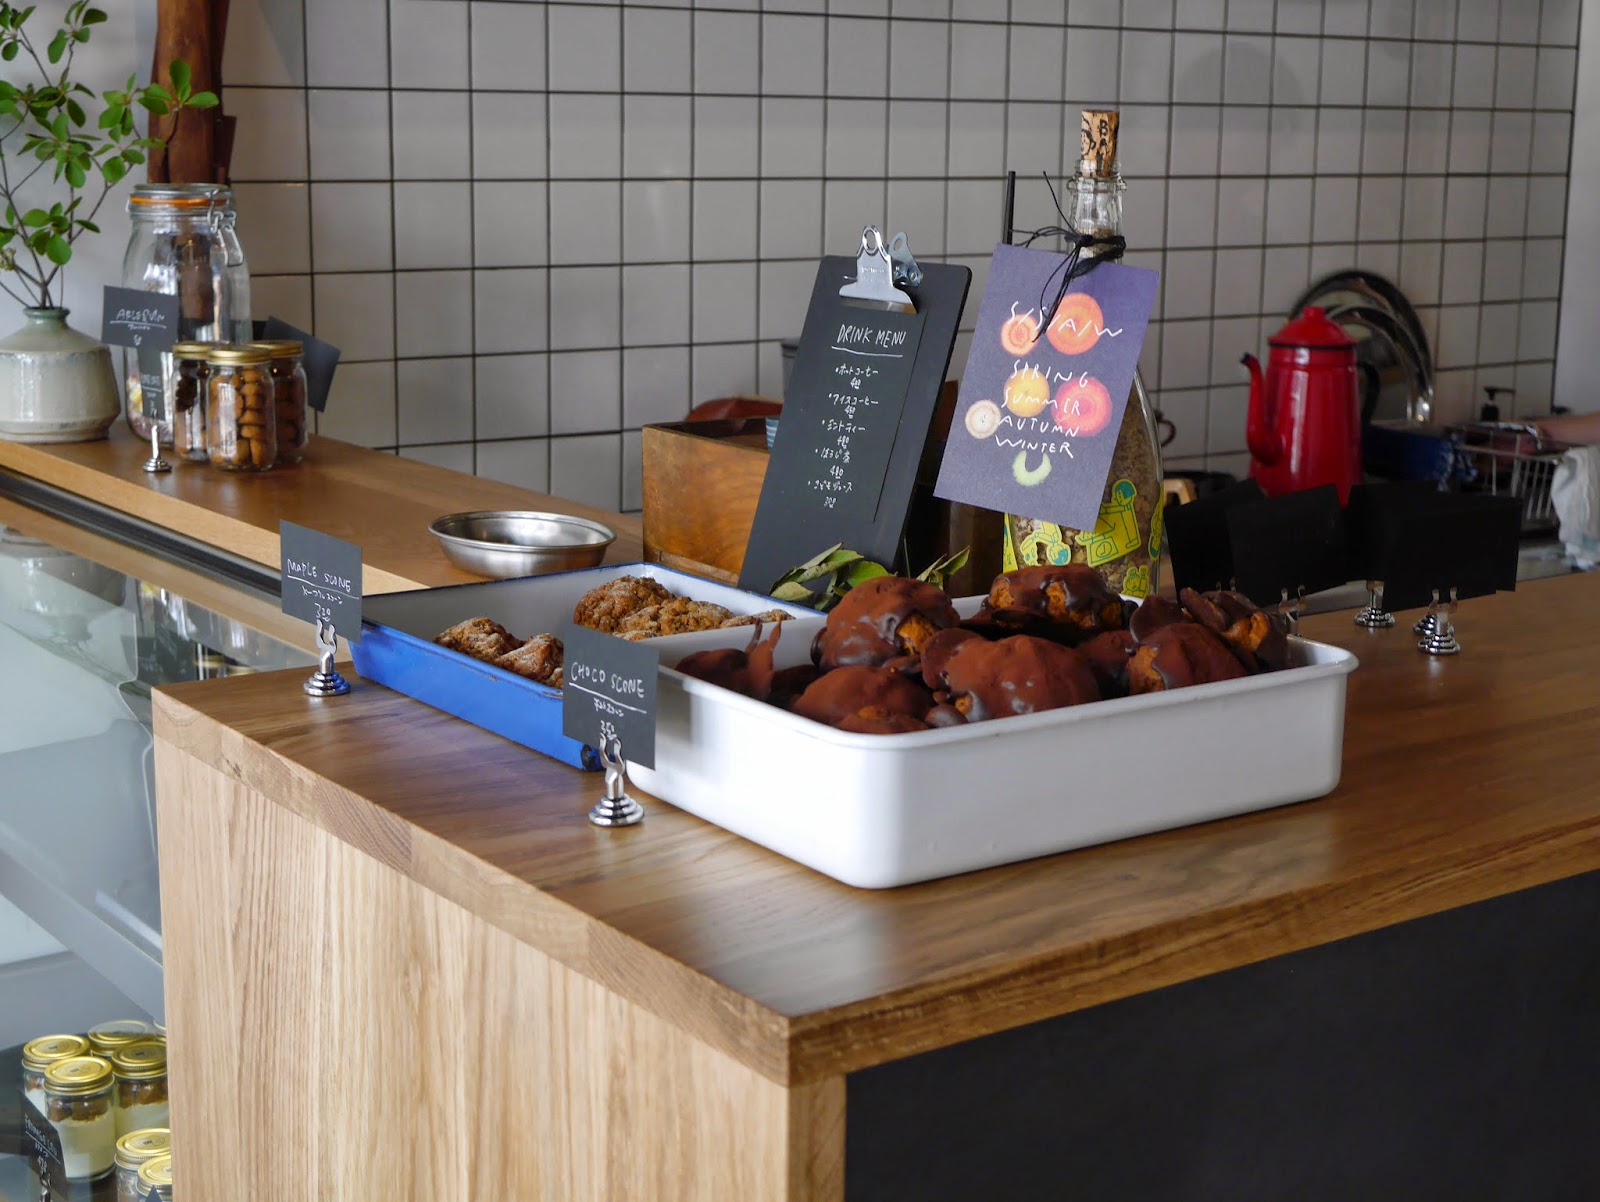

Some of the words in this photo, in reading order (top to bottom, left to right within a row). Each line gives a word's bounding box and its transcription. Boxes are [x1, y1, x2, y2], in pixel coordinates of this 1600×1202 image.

[836, 323, 874, 345] DRINK
[875, 329, 907, 349] MENU
[1010, 358, 1089, 389] SPRING
[1001, 386, 1081, 417] SUMMER
[998, 414, 1080, 438] AUTUMN
[994, 434, 1074, 459] WINTER
[286, 558, 318, 578] MAPLE
[323, 572, 351, 593] SCONE
[570, 661, 606, 684] CHOCO
[610, 673, 645, 699] SCONE
